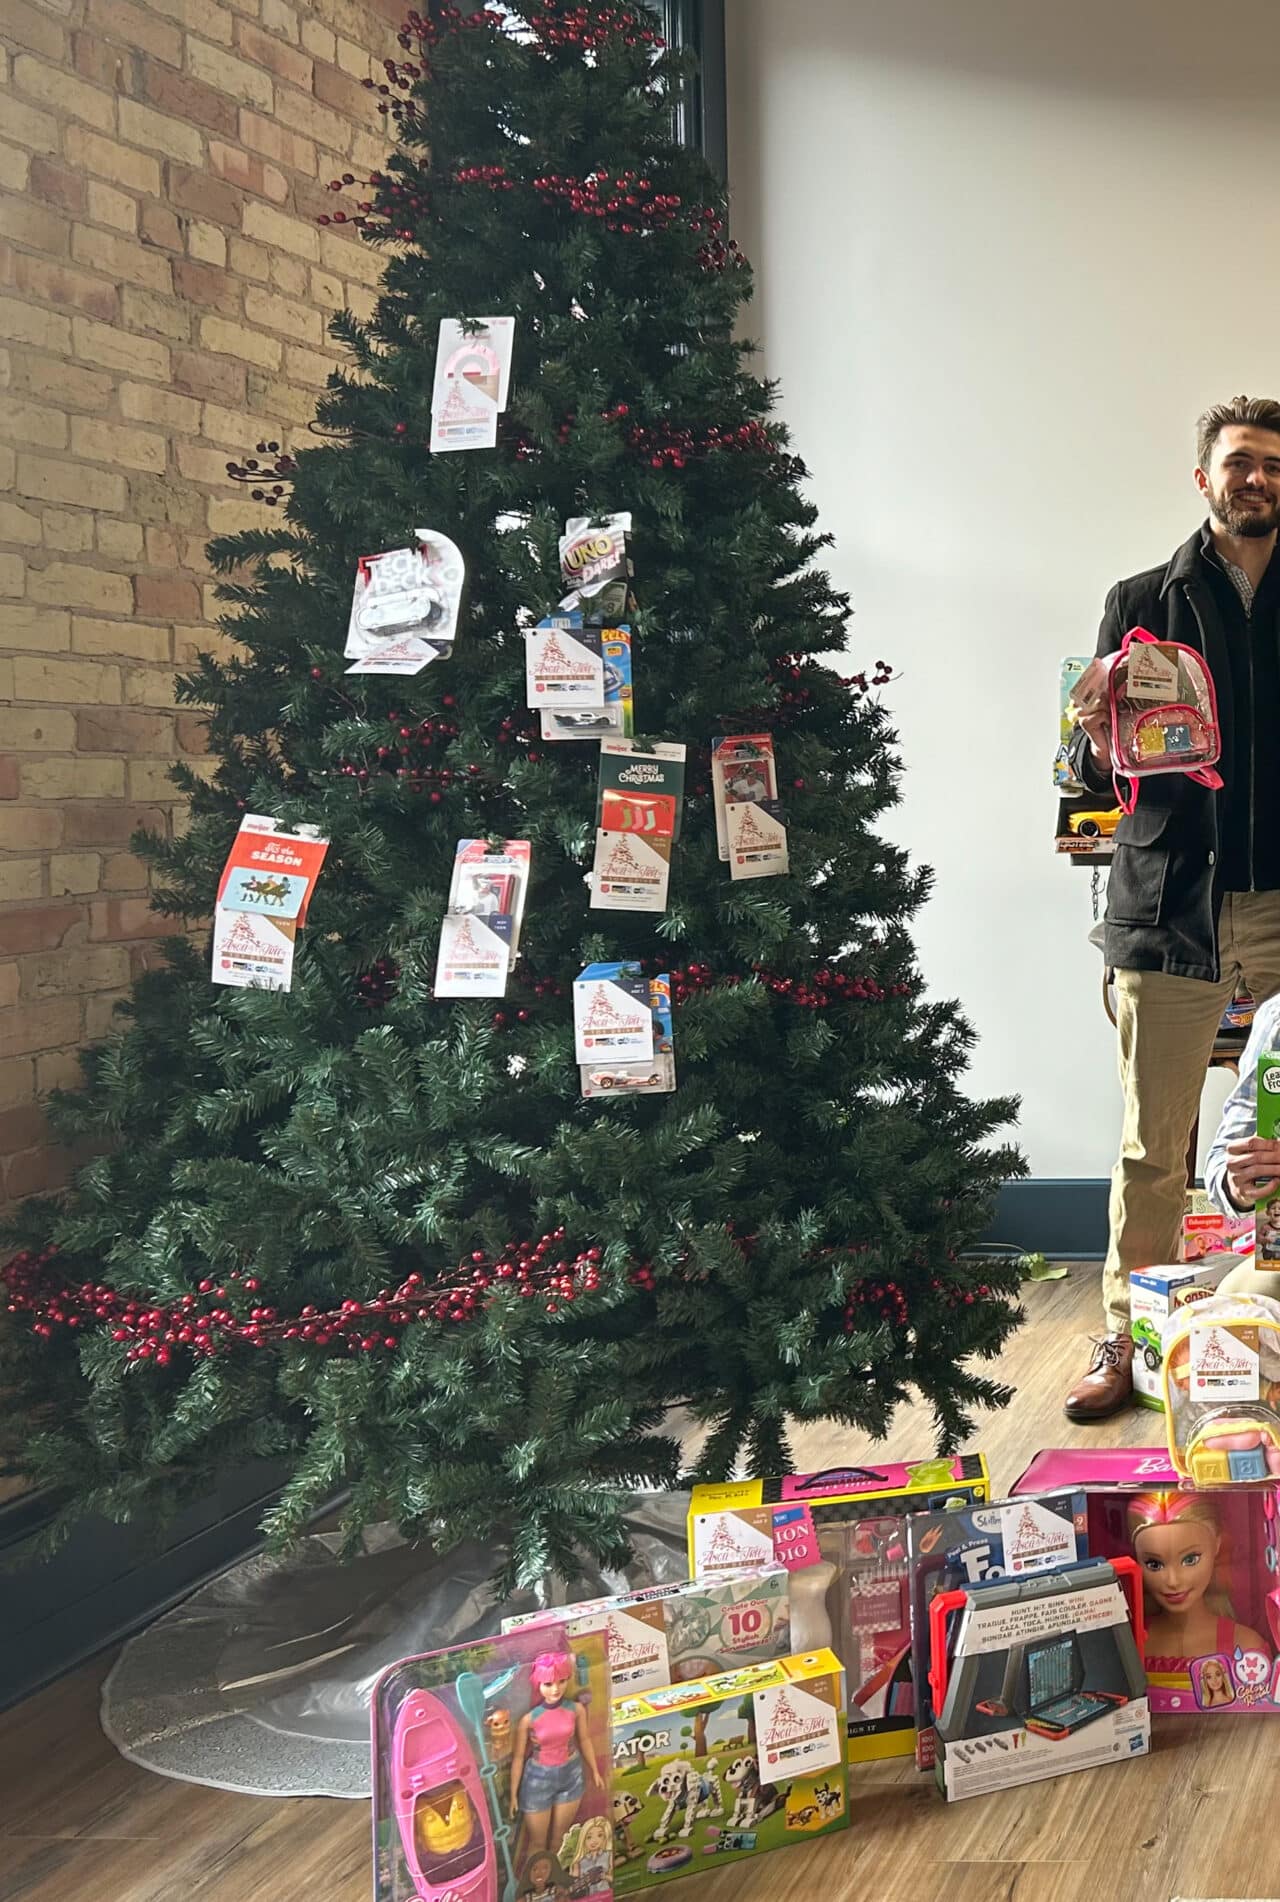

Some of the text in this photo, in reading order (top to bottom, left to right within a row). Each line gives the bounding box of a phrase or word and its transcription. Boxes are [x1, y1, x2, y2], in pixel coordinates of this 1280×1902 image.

[565, 536, 612, 570] UNO
[618, 773, 664, 785] CHRISTMAS
[626, 764, 659, 775] MERRY
[251, 851, 303, 866] SEASON
[774, 1523, 810, 1544] ION
[775, 1545, 808, 1564] DIO
[721, 1603, 748, 1613] Create
[728, 1610, 761, 1635] 10
[613, 1731, 671, 1758] ATOR
